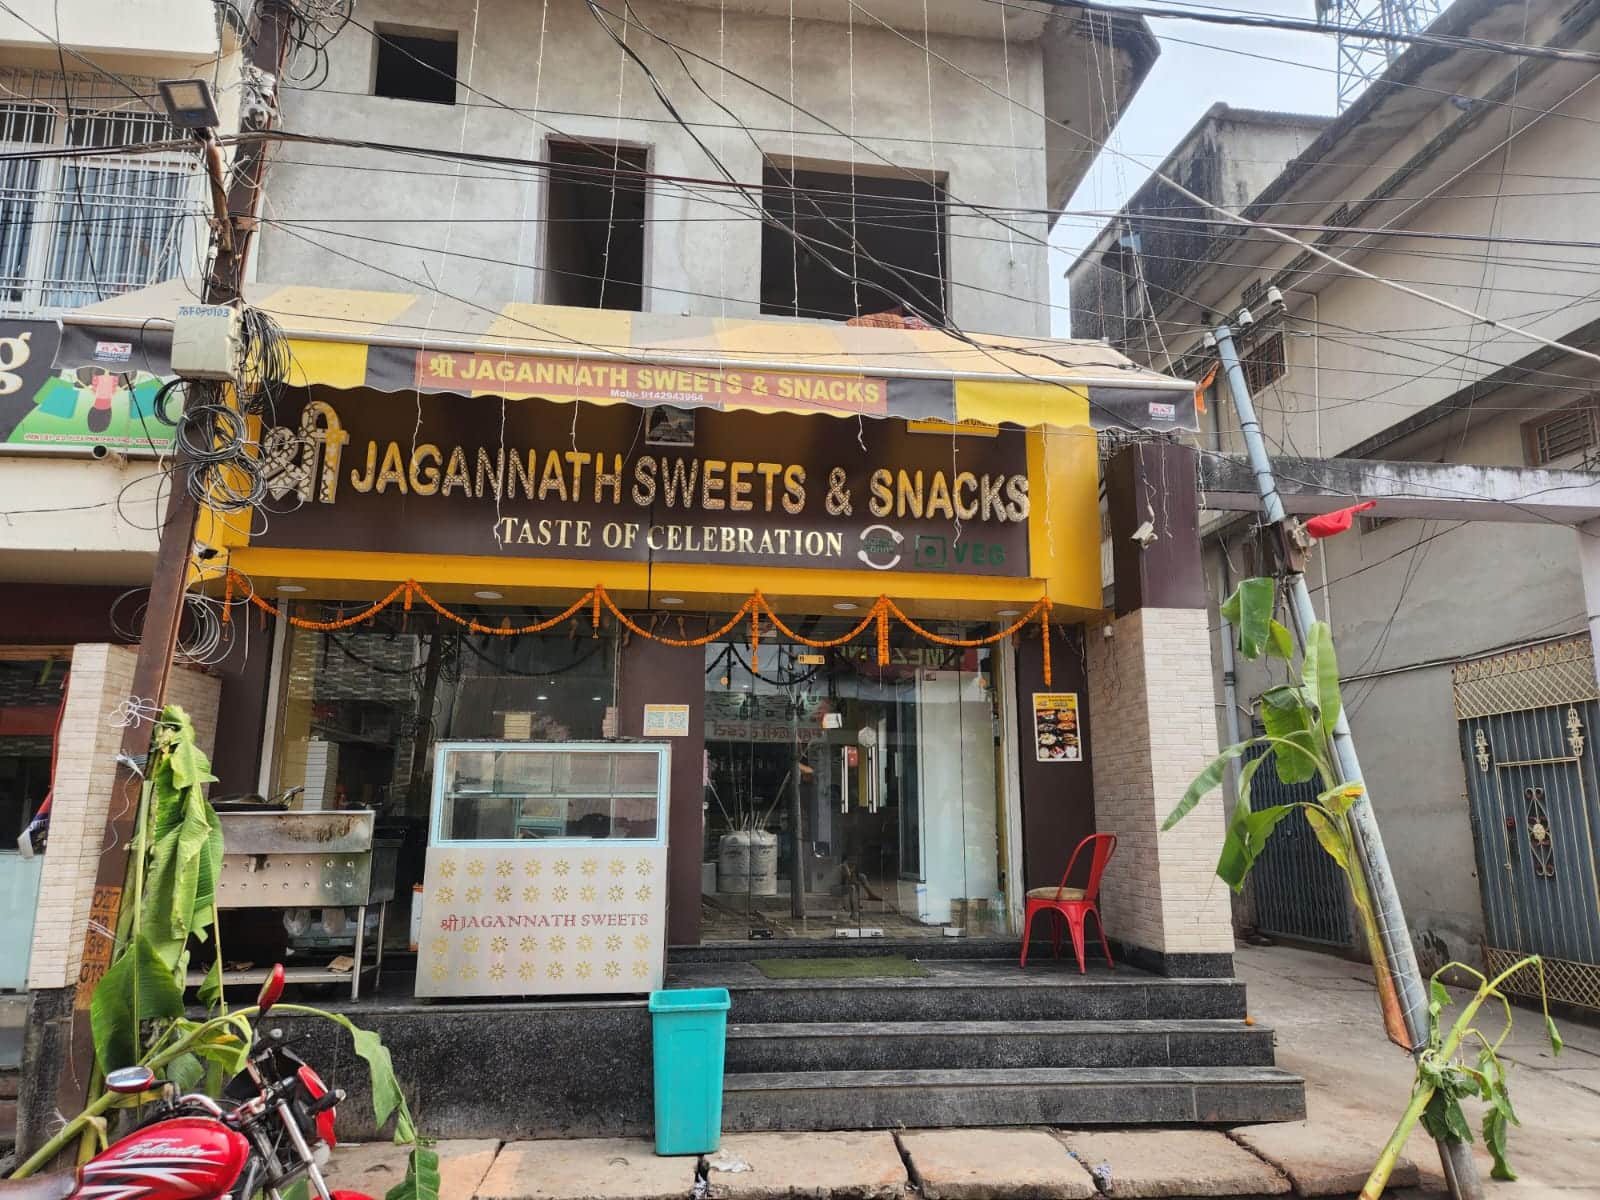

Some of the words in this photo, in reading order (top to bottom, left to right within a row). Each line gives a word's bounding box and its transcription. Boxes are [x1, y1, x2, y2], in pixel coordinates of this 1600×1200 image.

[429, 354, 457, 378] श्री
[460, 358, 628, 389] JAGANNATH
[636, 367, 743, 394] SWEETS
[751, 375, 769, 397] &
[777, 377, 880, 403] SNACKS
[262, 400, 350, 504] श्री
[351, 440, 622, 504] JAGANNATH
[631, 455, 807, 515] SWEETS
[826, 466, 853, 517] &
[868, 468, 1030, 523] SNACKS
[500, 516, 591, 548] TASTE
[602, 522, 640, 549] OF
[646, 523, 843, 558] CELEBRATION
[952, 542, 1006, 567] VEG
[458, 914, 576, 932] JAGANNATH
[581, 913, 649, 927] SWEETS
